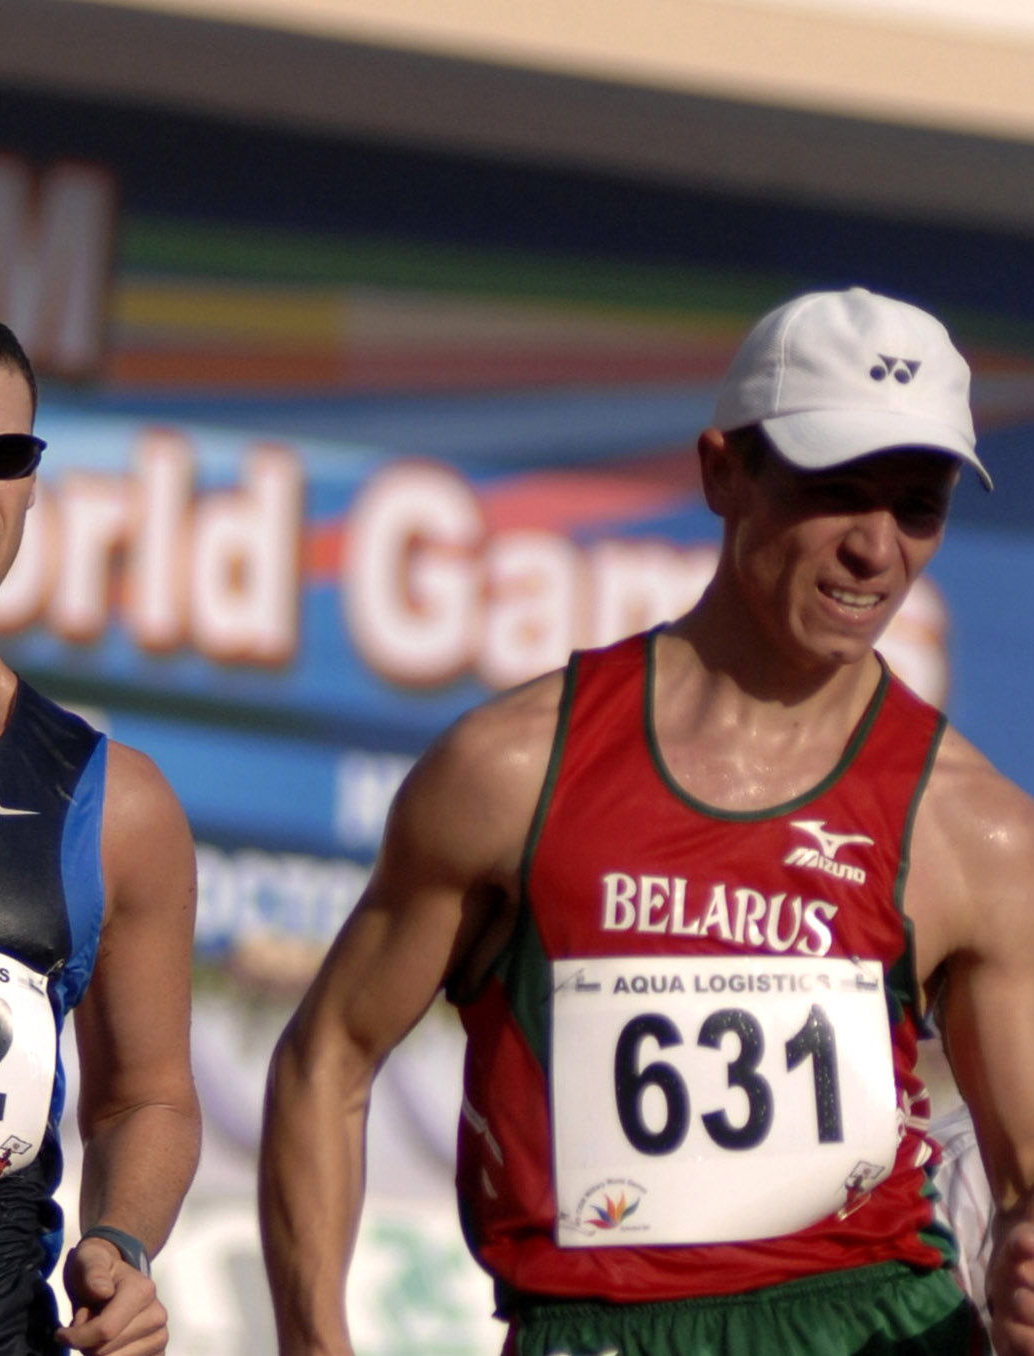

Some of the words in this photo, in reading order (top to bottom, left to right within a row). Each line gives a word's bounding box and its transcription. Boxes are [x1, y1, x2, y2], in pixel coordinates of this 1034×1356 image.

[602, 872, 838, 956] BELARUS
[613, 973, 686, 995] AQUA
[614, 1003, 844, 1157] 631
